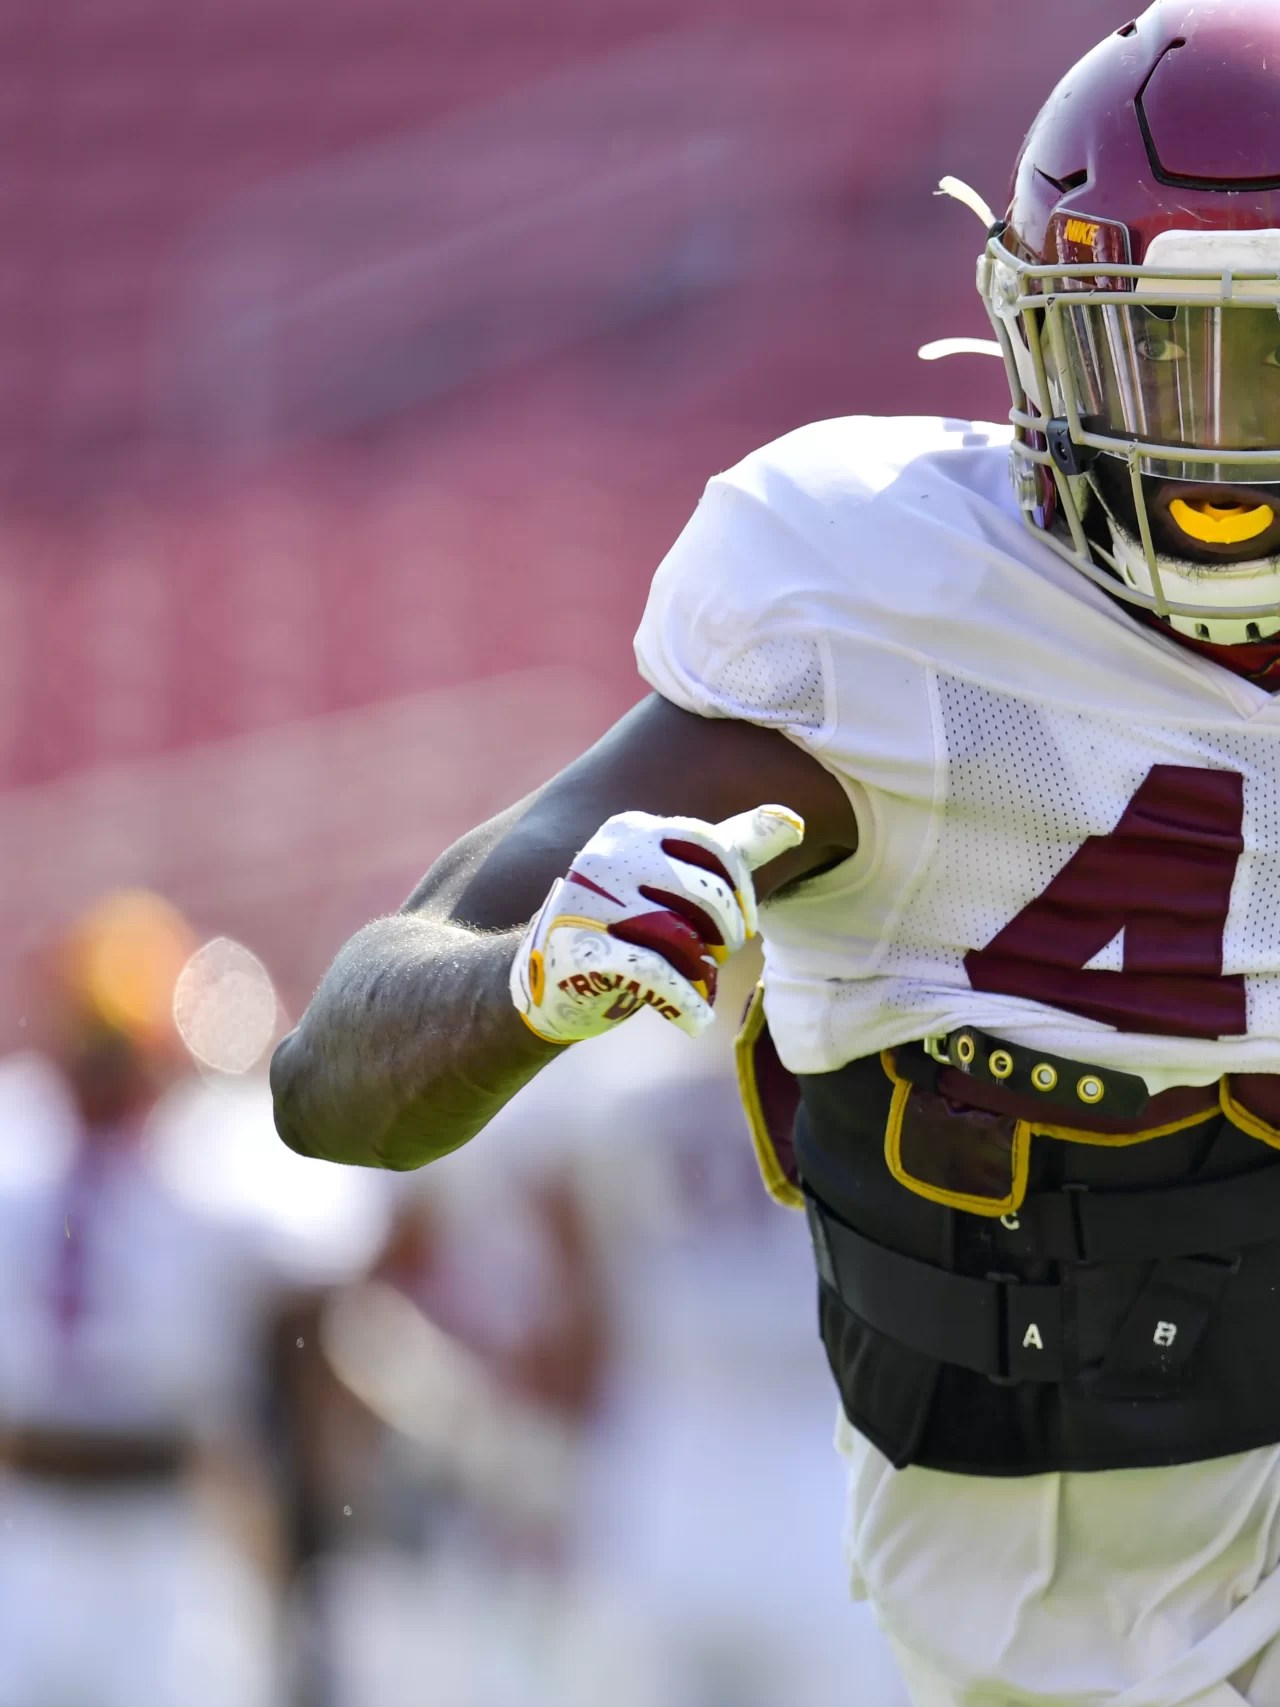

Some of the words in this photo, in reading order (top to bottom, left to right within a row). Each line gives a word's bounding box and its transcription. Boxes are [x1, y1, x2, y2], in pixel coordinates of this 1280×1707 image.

[1063, 218, 1100, 246] NIKE
[1022, 1323, 1044, 1349] A
[1153, 1320, 1177, 1347] B
